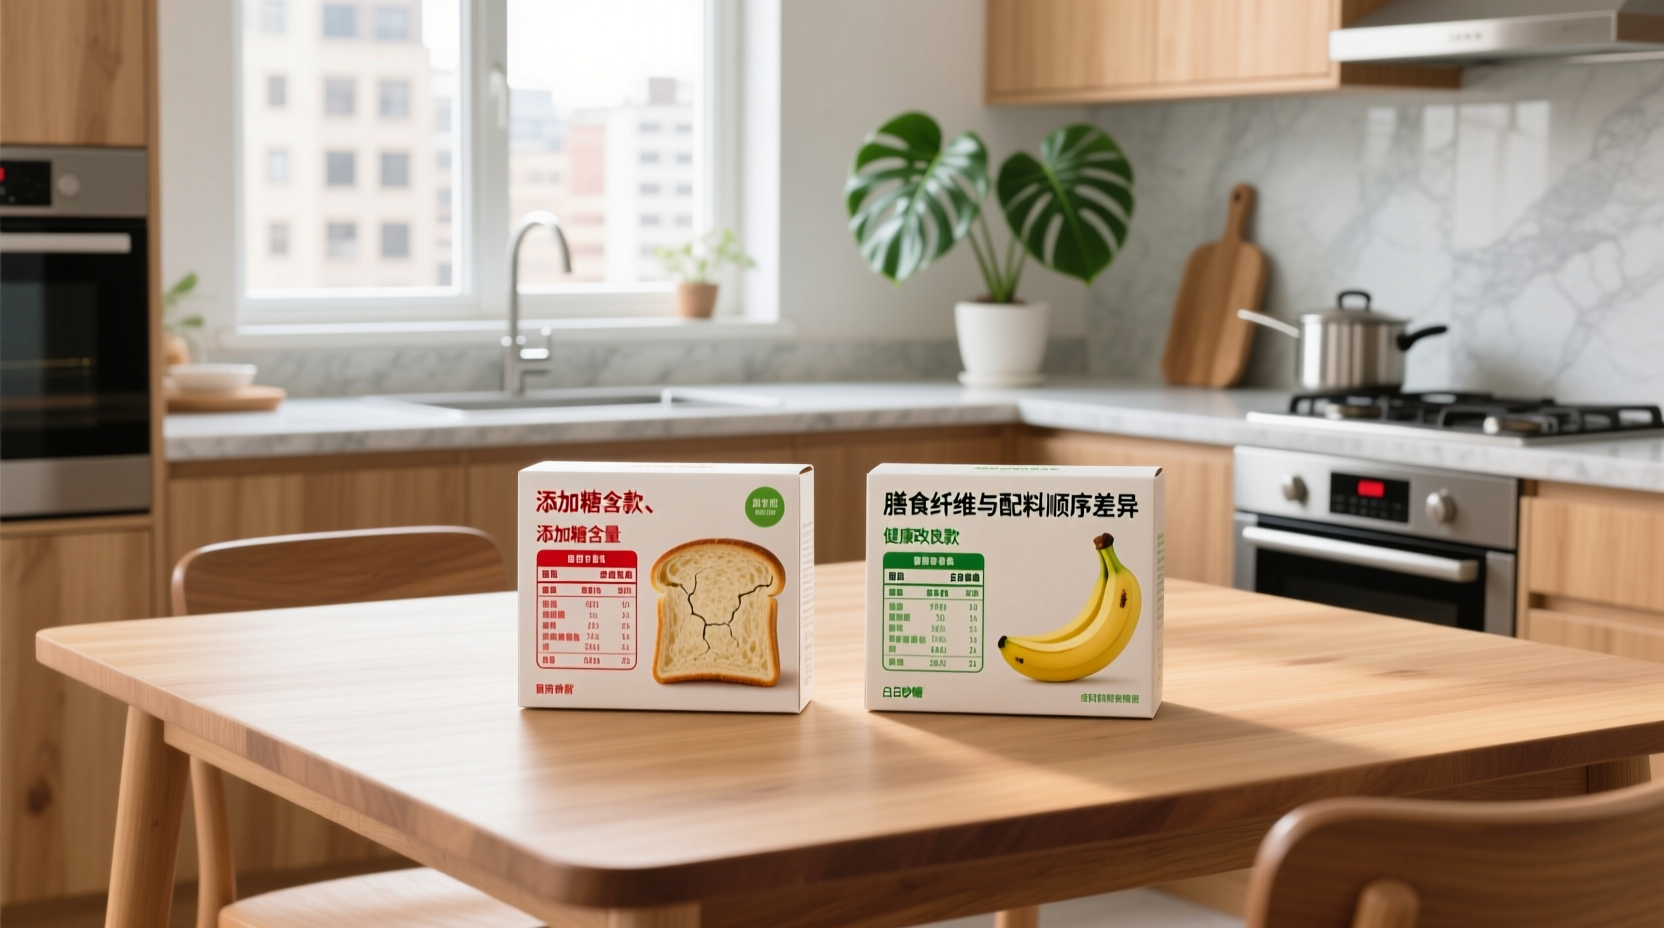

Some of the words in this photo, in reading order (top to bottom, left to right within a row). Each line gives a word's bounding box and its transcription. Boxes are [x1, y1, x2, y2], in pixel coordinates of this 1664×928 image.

[883, 490, 1139, 519] 膳食纤维与配料顺序差异
[536, 524, 621, 544] 添加糖含量
[883, 526, 960, 546] 健康改良款
